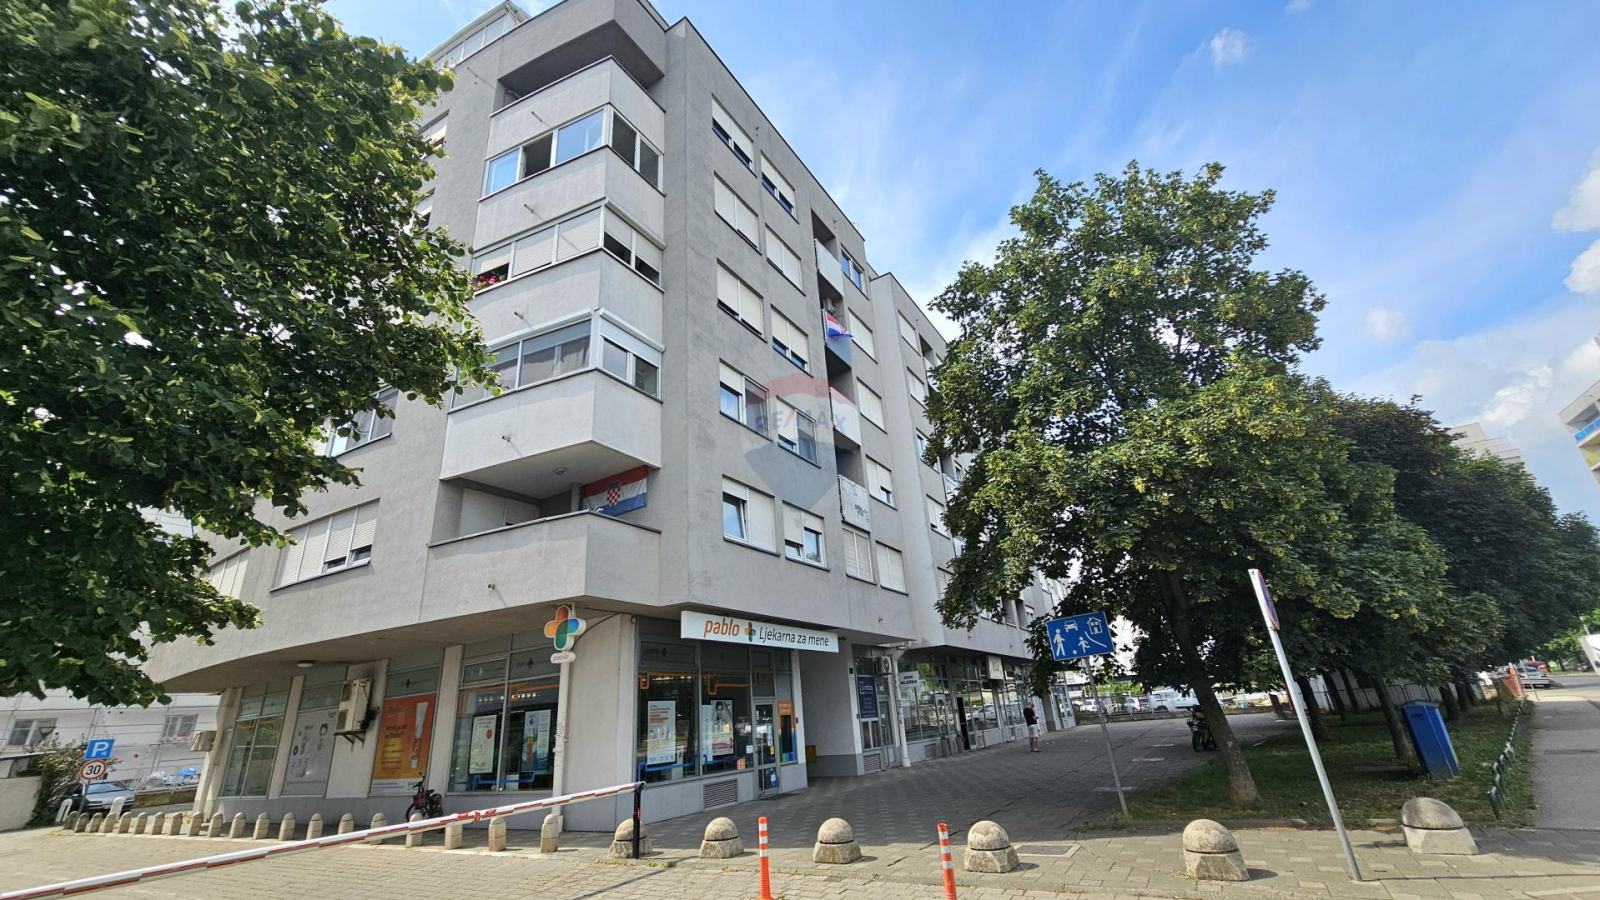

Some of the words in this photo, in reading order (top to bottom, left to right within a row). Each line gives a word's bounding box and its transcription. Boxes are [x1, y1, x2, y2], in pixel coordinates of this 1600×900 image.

[704, 617, 740, 638] pablo
[759, 626, 795, 643] Ljekarna
[797, 634, 806, 644] za
[808, 635, 829, 647] mene
[91, 741, 109, 757] P
[86, 765, 101, 775] 30
